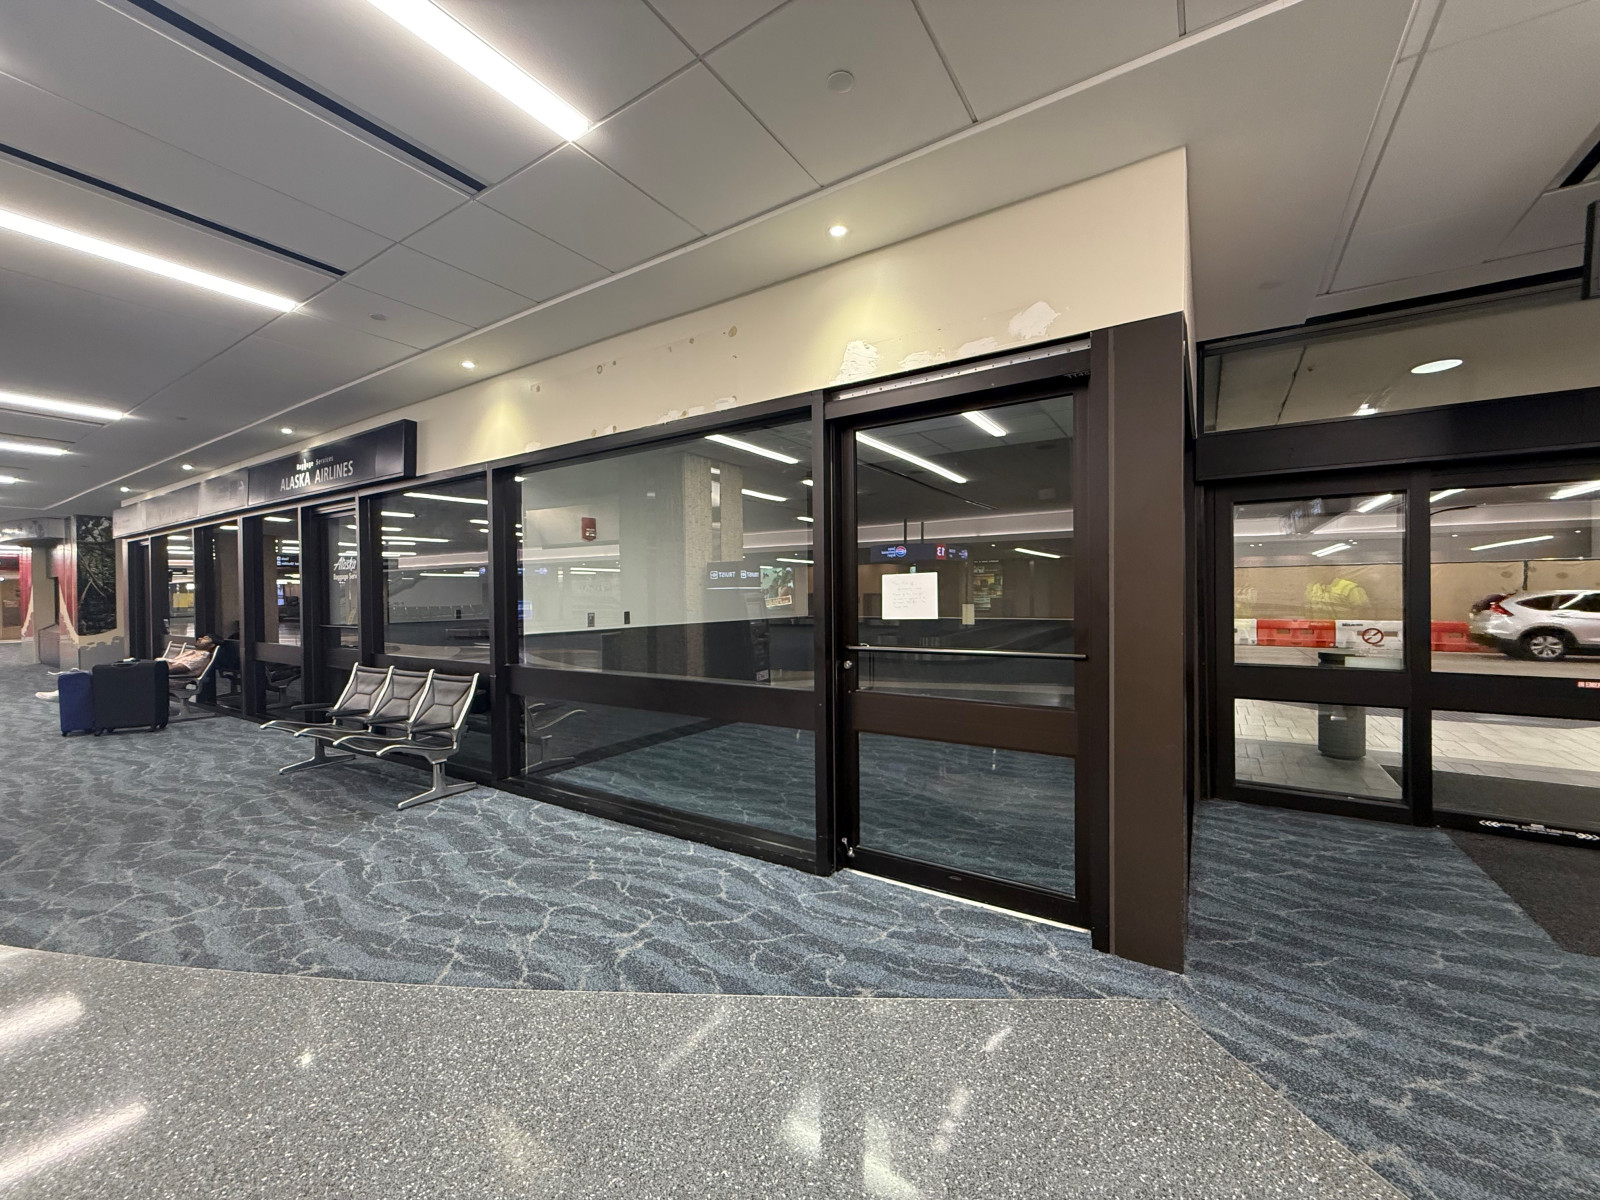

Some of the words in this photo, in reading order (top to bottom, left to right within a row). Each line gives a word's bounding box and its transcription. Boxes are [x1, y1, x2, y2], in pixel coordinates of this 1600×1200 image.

[315, 456, 334, 466] Services
[280, 471, 311, 492] ALASKA
[314, 460, 354, 484] AIRLINES
[333, 556, 357, 571] Alaska
